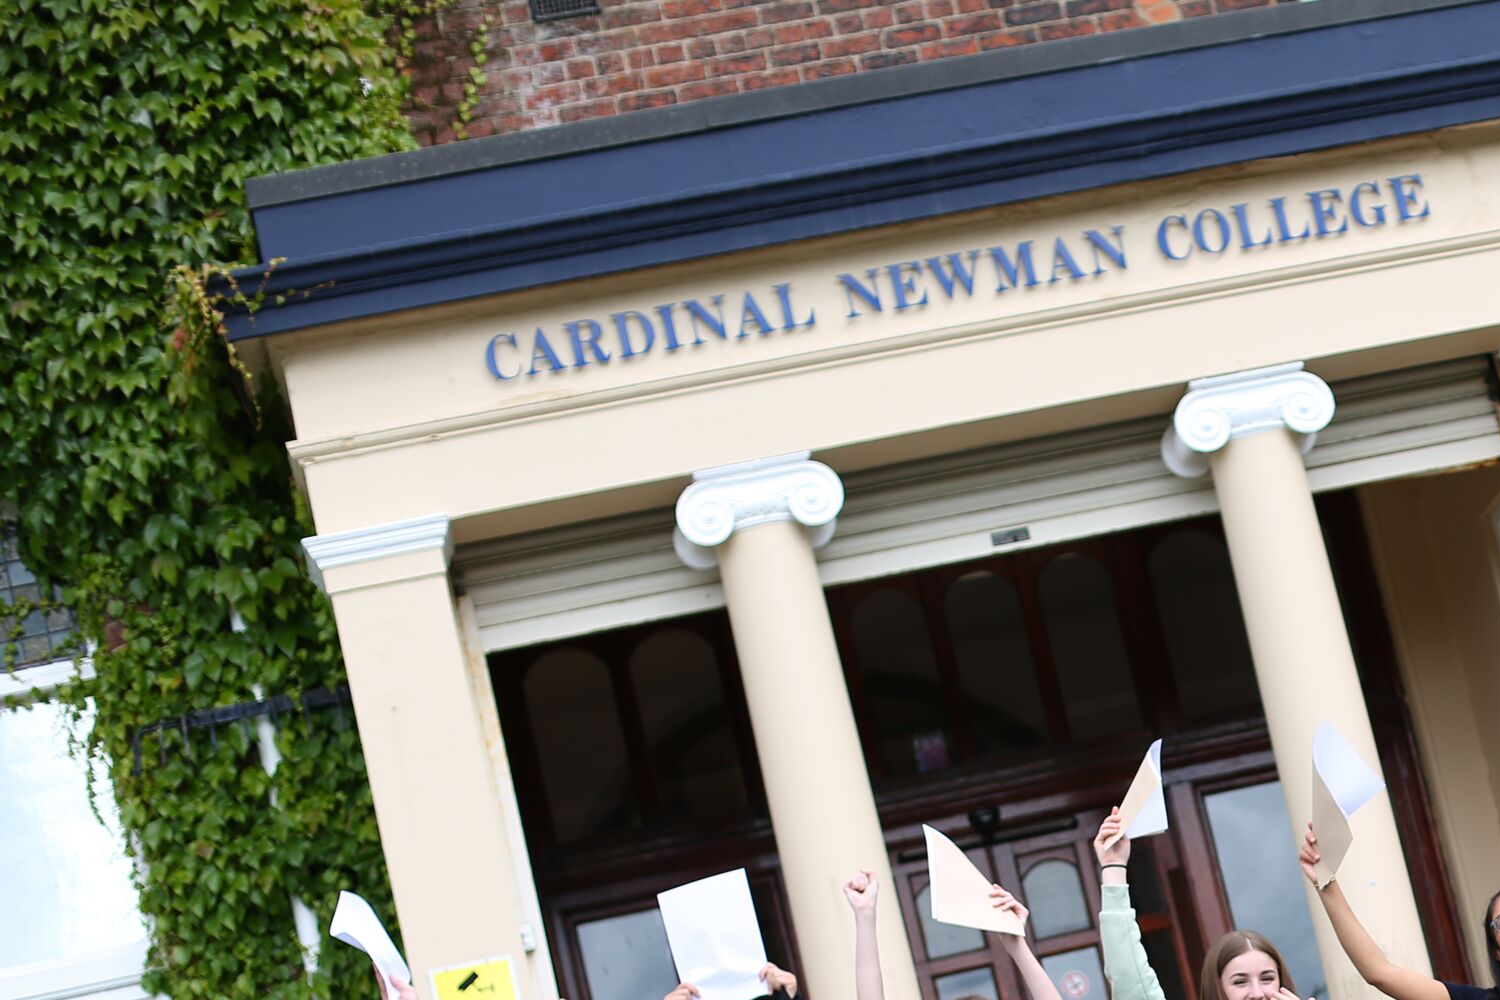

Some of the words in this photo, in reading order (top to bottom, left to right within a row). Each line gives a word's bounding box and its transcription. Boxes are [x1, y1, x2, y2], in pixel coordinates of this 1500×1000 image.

[484, 283, 816, 380] CARDINAL
[837, 225, 1128, 318] NEWMAN
[1156, 173, 1430, 260] COLLEGE
